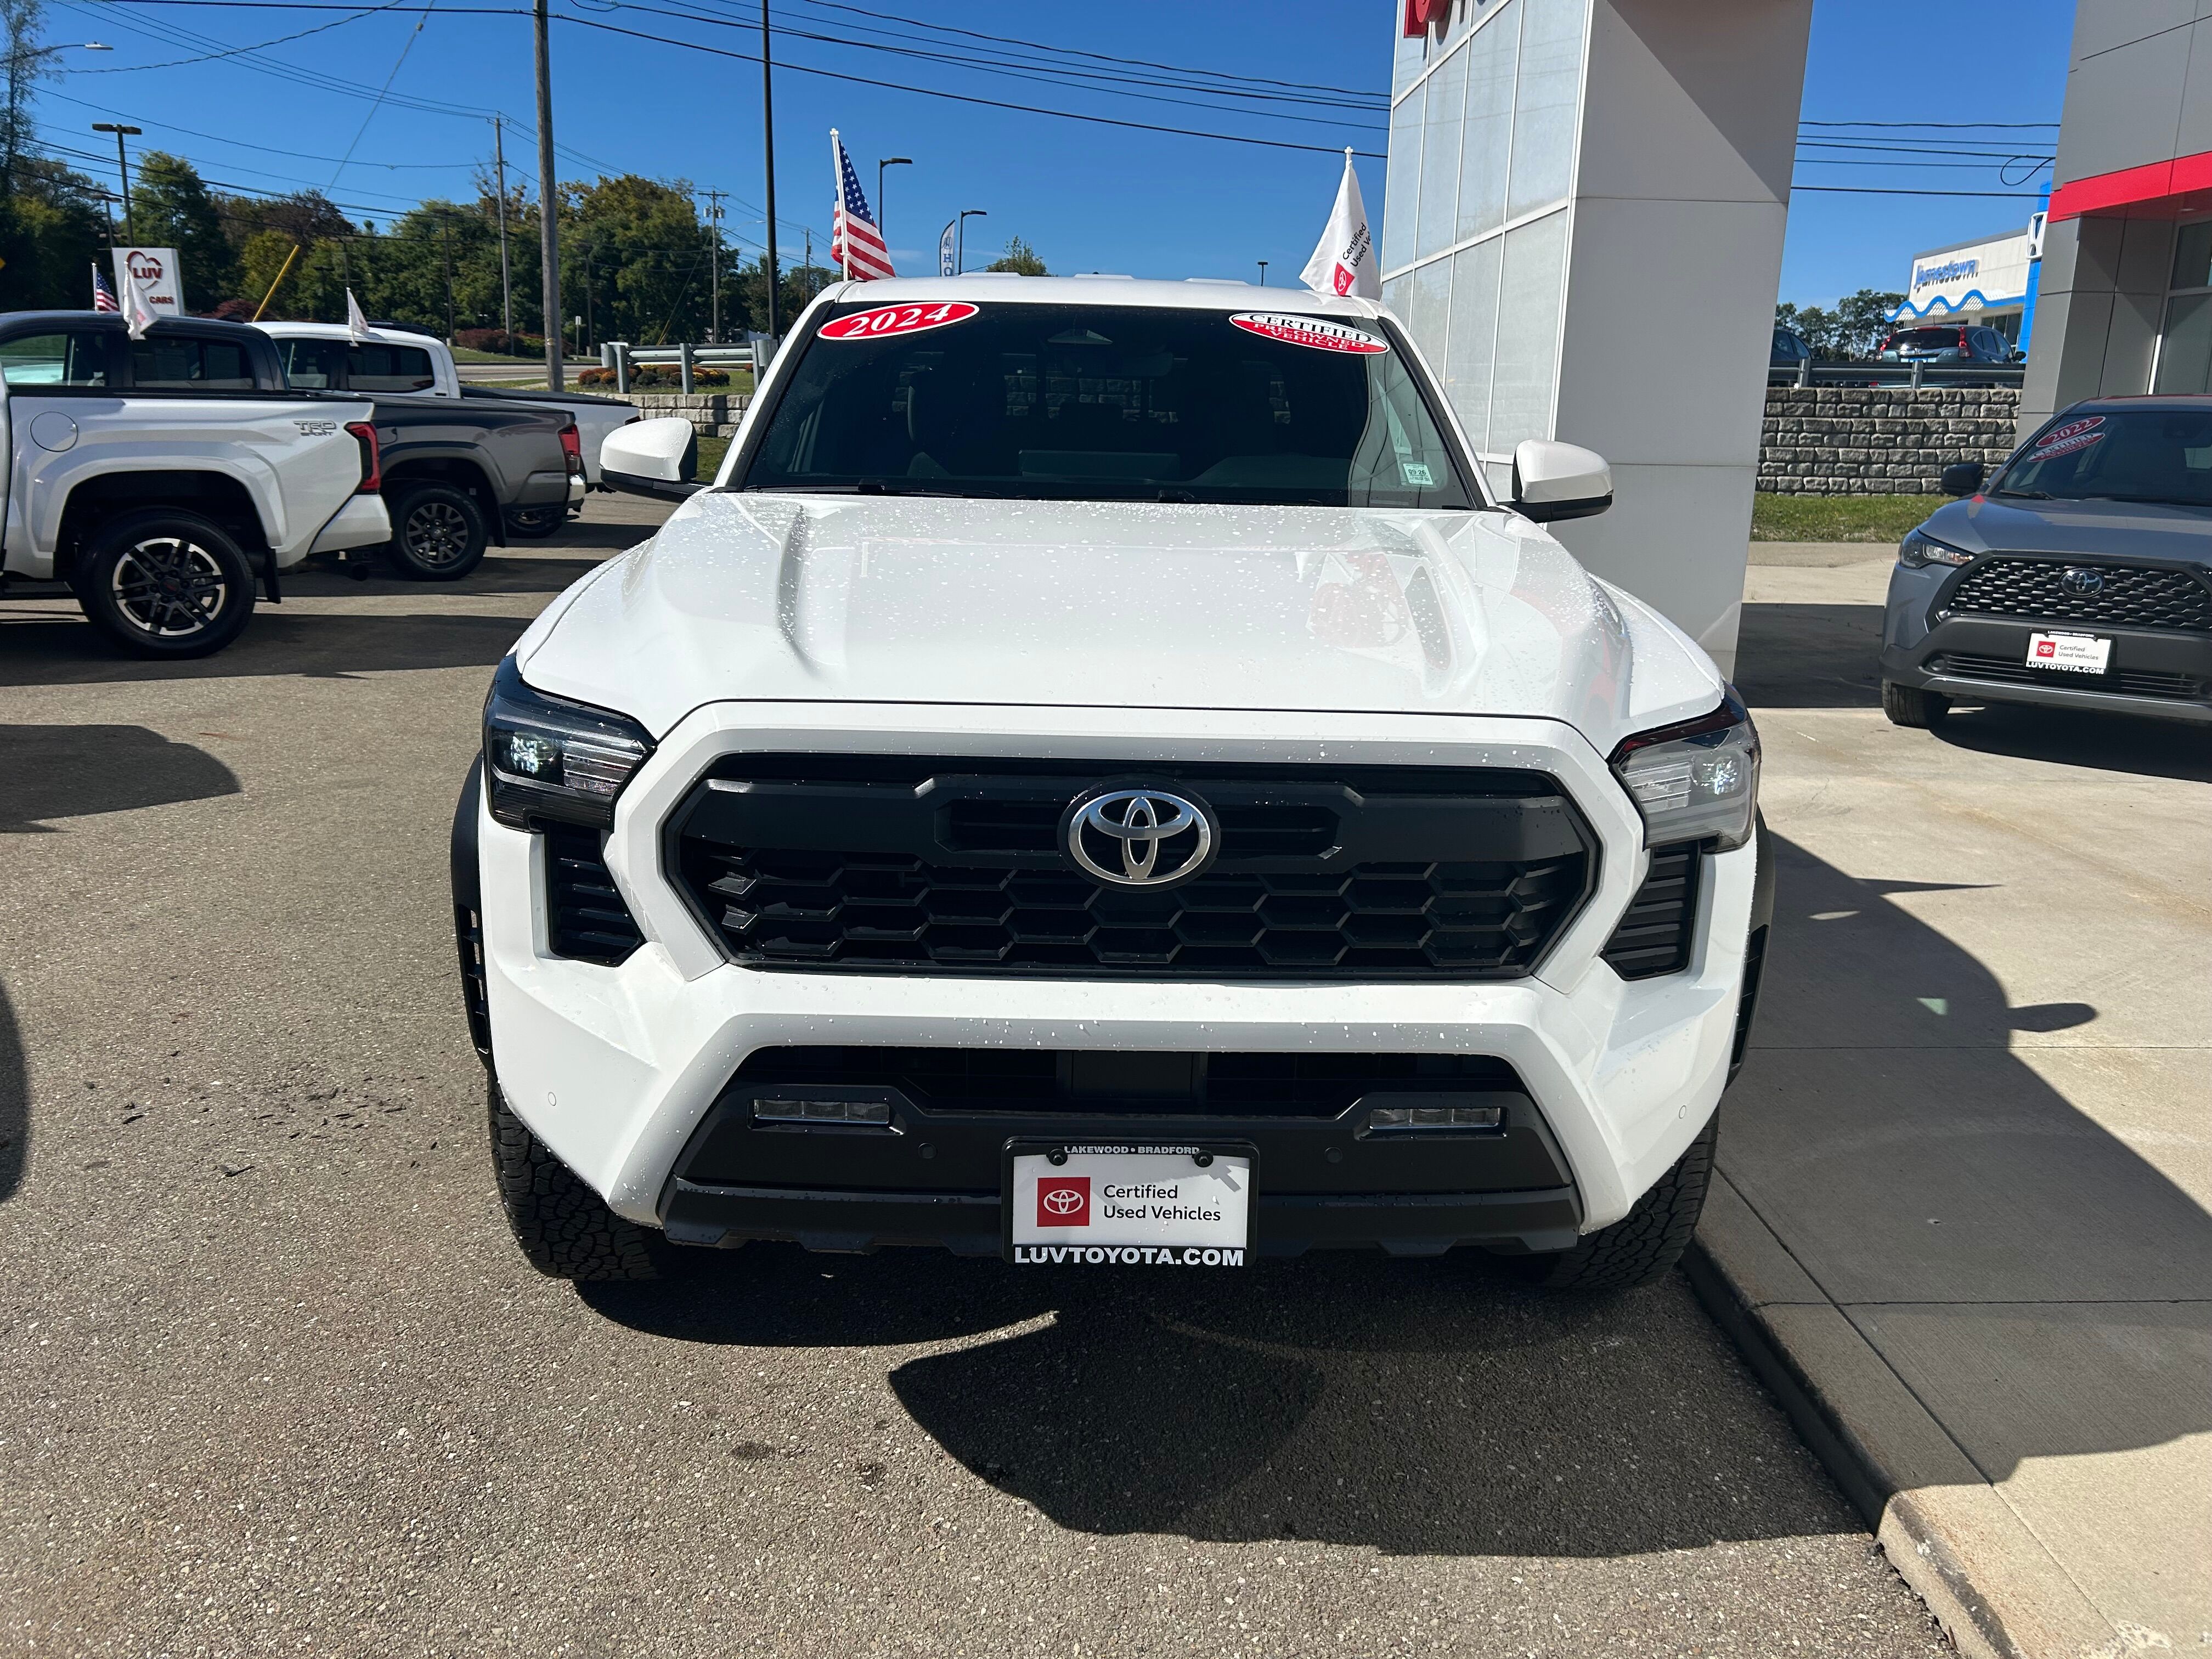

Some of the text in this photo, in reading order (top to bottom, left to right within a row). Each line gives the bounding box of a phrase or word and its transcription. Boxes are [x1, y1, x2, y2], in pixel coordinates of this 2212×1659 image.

[1342, 222, 1367, 260] Certified
[1350, 244, 1367, 267] Used
[133, 267, 163, 279] LUV
[149, 296, 174, 304] CARS
[842, 304, 952, 337] 2024
[1249, 315, 1372, 342] CERTIFIED
[1253, 323, 1365, 348] PRE-OWNED
[1269, 330, 1348, 350] VEHICLE
[294, 420, 337, 433] TRD
[2049, 420, 2092, 443] 2022
[2025, 661, 2104, 675] LUVTOYOTA.COM
[1064, 1146, 1200, 1155] LAKEWOOD BRADFORD
[1103, 1184, 1178, 1199] Certified
[1103, 1205, 1221, 1221] Used Vehicles
[1014, 1246, 1244, 1267] LUVTOYOTA.COM
